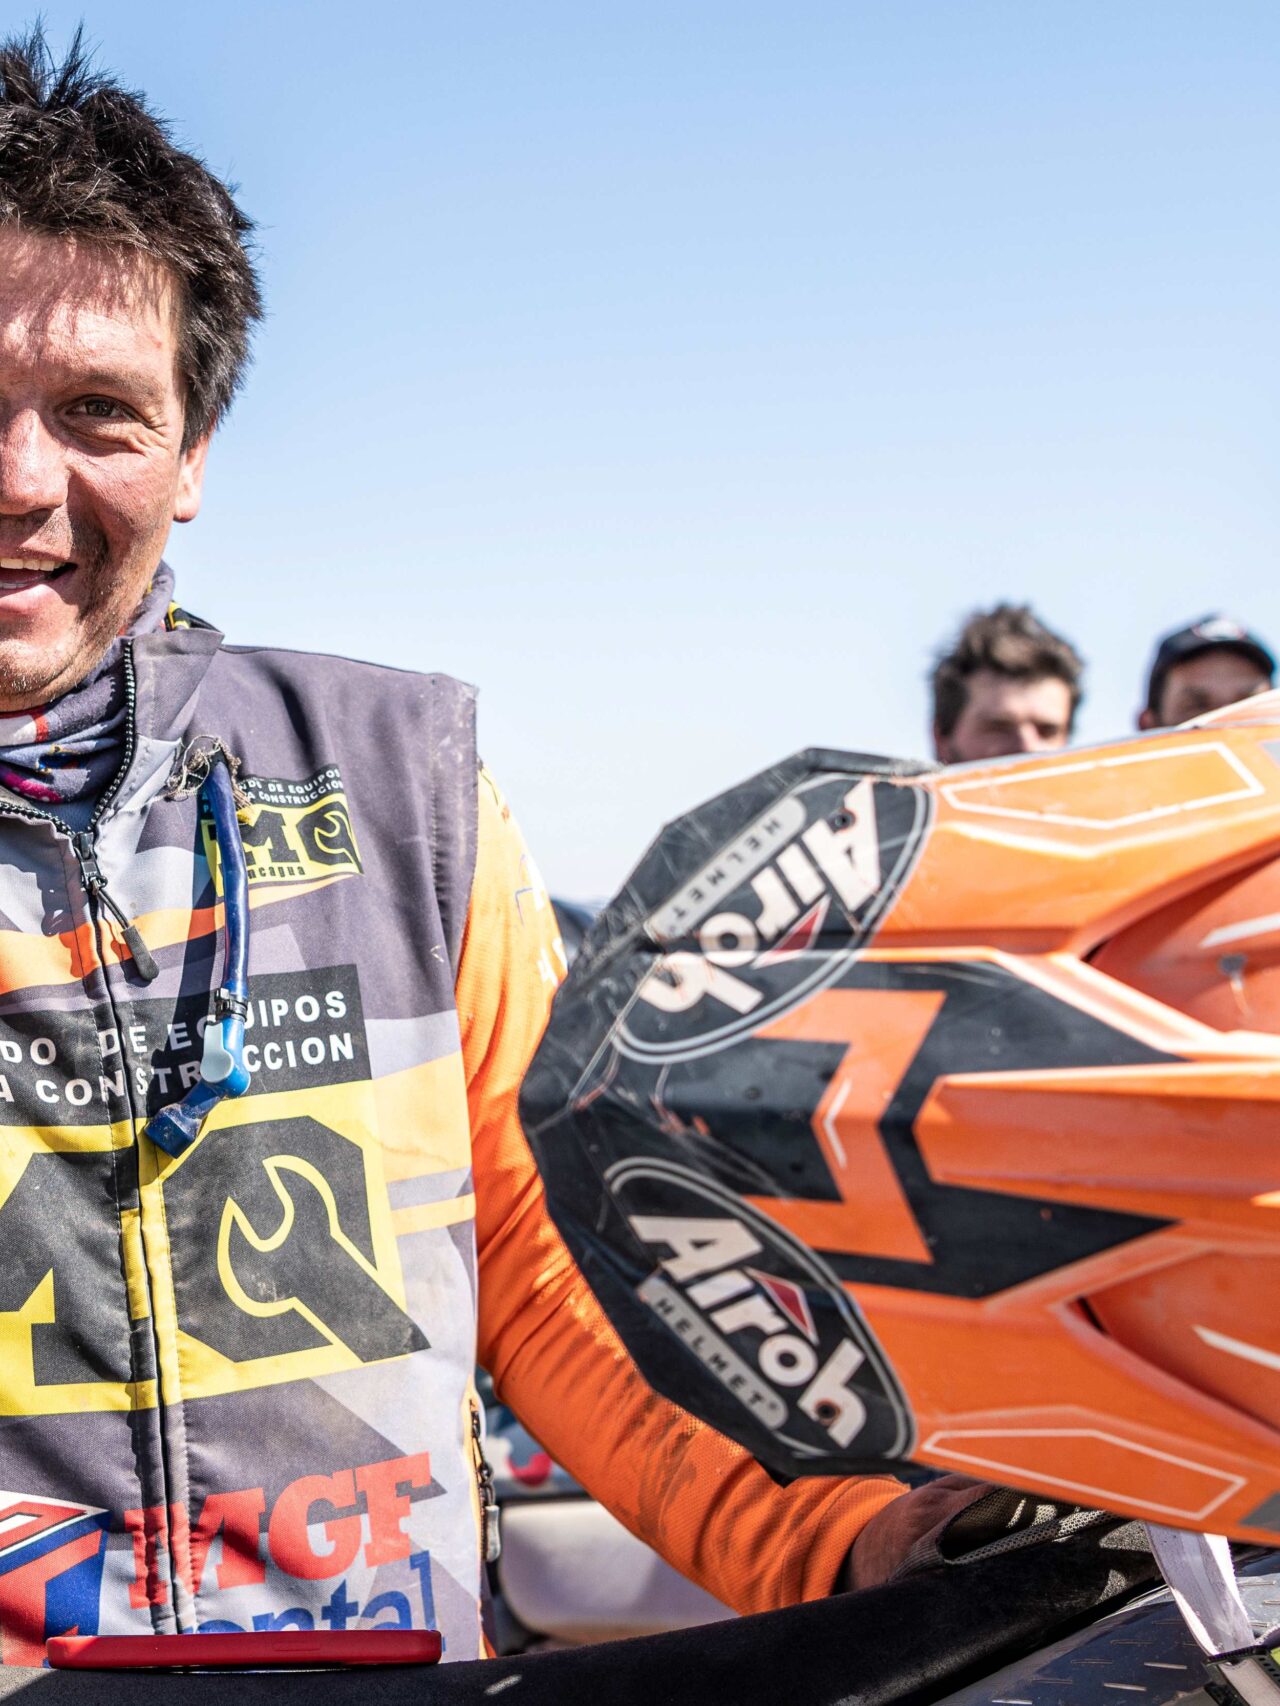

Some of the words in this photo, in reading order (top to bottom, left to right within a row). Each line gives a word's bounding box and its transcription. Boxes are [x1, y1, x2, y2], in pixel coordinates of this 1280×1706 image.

[267, 782, 284, 793] DE
[246, 865, 306, 880] ncagua
[636, 775, 882, 1015] Airoh
[673, 818, 783, 920] HELMET
[35, 1032, 355, 1106] CONSTRCCION
[98, 1025, 148, 1058] DE
[627, 1214, 869, 1449] Airoh
[655, 1298, 765, 1408] HELMET
[123, 1451, 433, 1610] MGF
[183, 1549, 446, 1652] ntal
